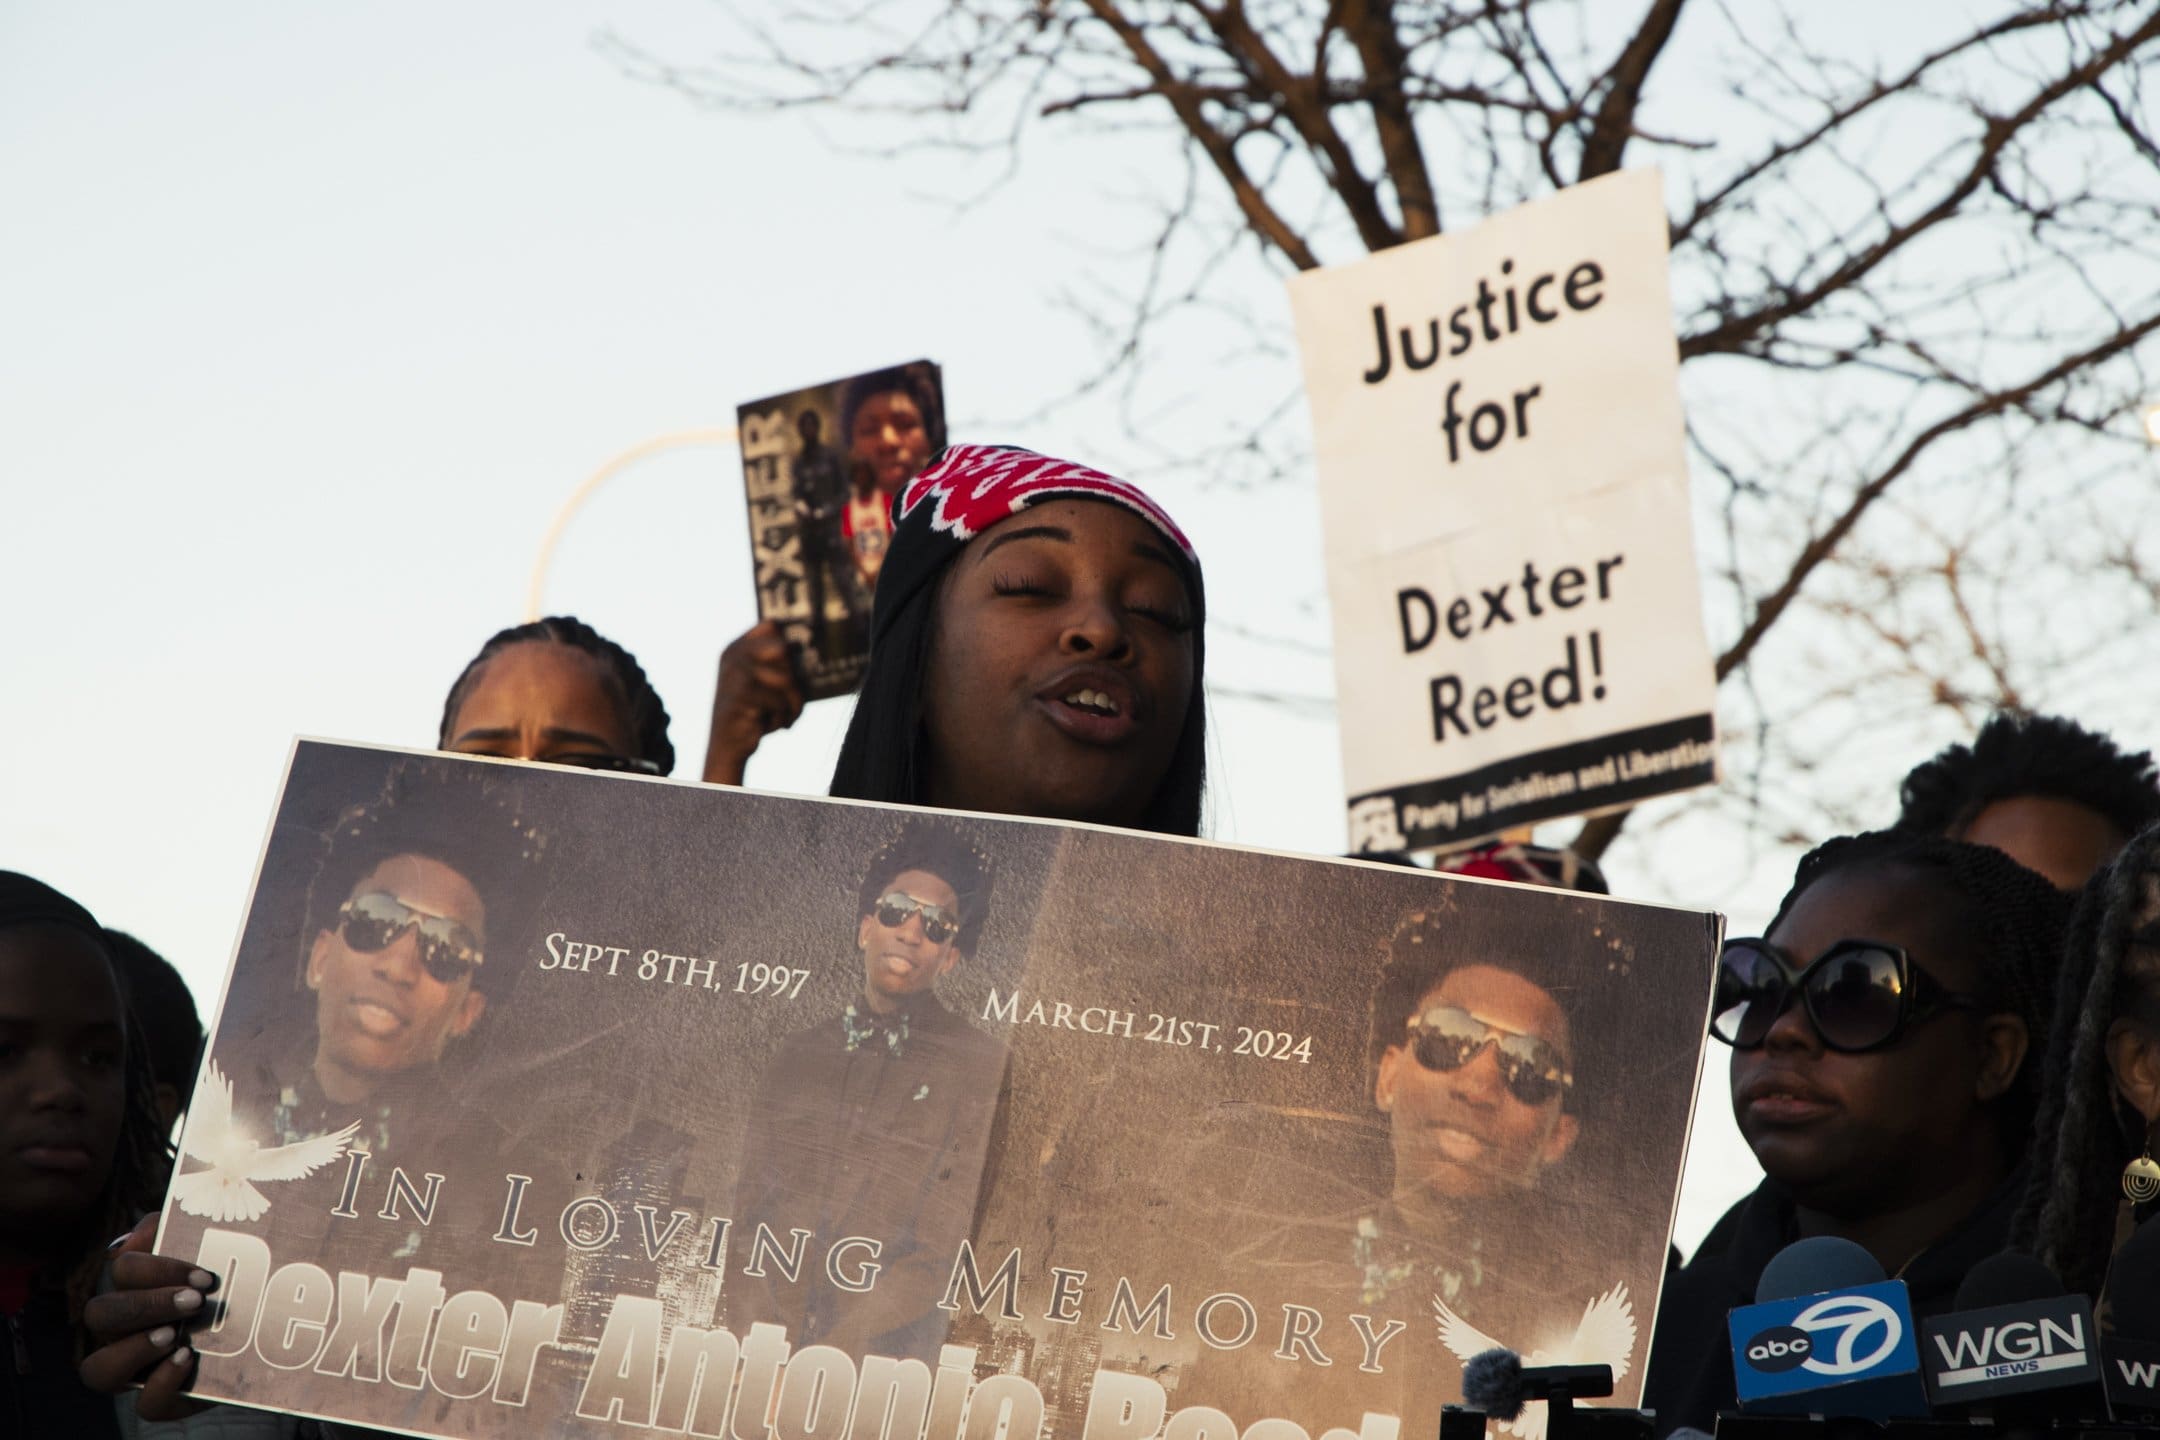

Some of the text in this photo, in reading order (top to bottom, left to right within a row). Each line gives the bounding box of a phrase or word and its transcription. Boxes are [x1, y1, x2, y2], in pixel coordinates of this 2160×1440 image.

[1363, 258, 1605, 384] Justice
[1440, 380, 1542, 464] for
[1396, 554, 1625, 655] Dexter
[1428, 628, 1607, 743] Reed!
[1402, 801, 1459, 831] Party
[1487, 771, 1576, 812] Socialism
[1578, 755, 1617, 790] and
[637, 949, 721, 993] 8TH,
[733, 962, 811, 1000] 1997
[1143, 1013, 1222, 1054] 21ST,
[1233, 1026, 1313, 1064] 2024
[193, 1228, 566, 1408] Dexter
[575, 1294, 1046, 1440] Antonio
[1748, 1338, 1810, 1361] abc
[1933, 1313, 2086, 1370] WGN
[1985, 1360, 2040, 1379] NEWS
[2116, 1359, 2160, 1388] W
